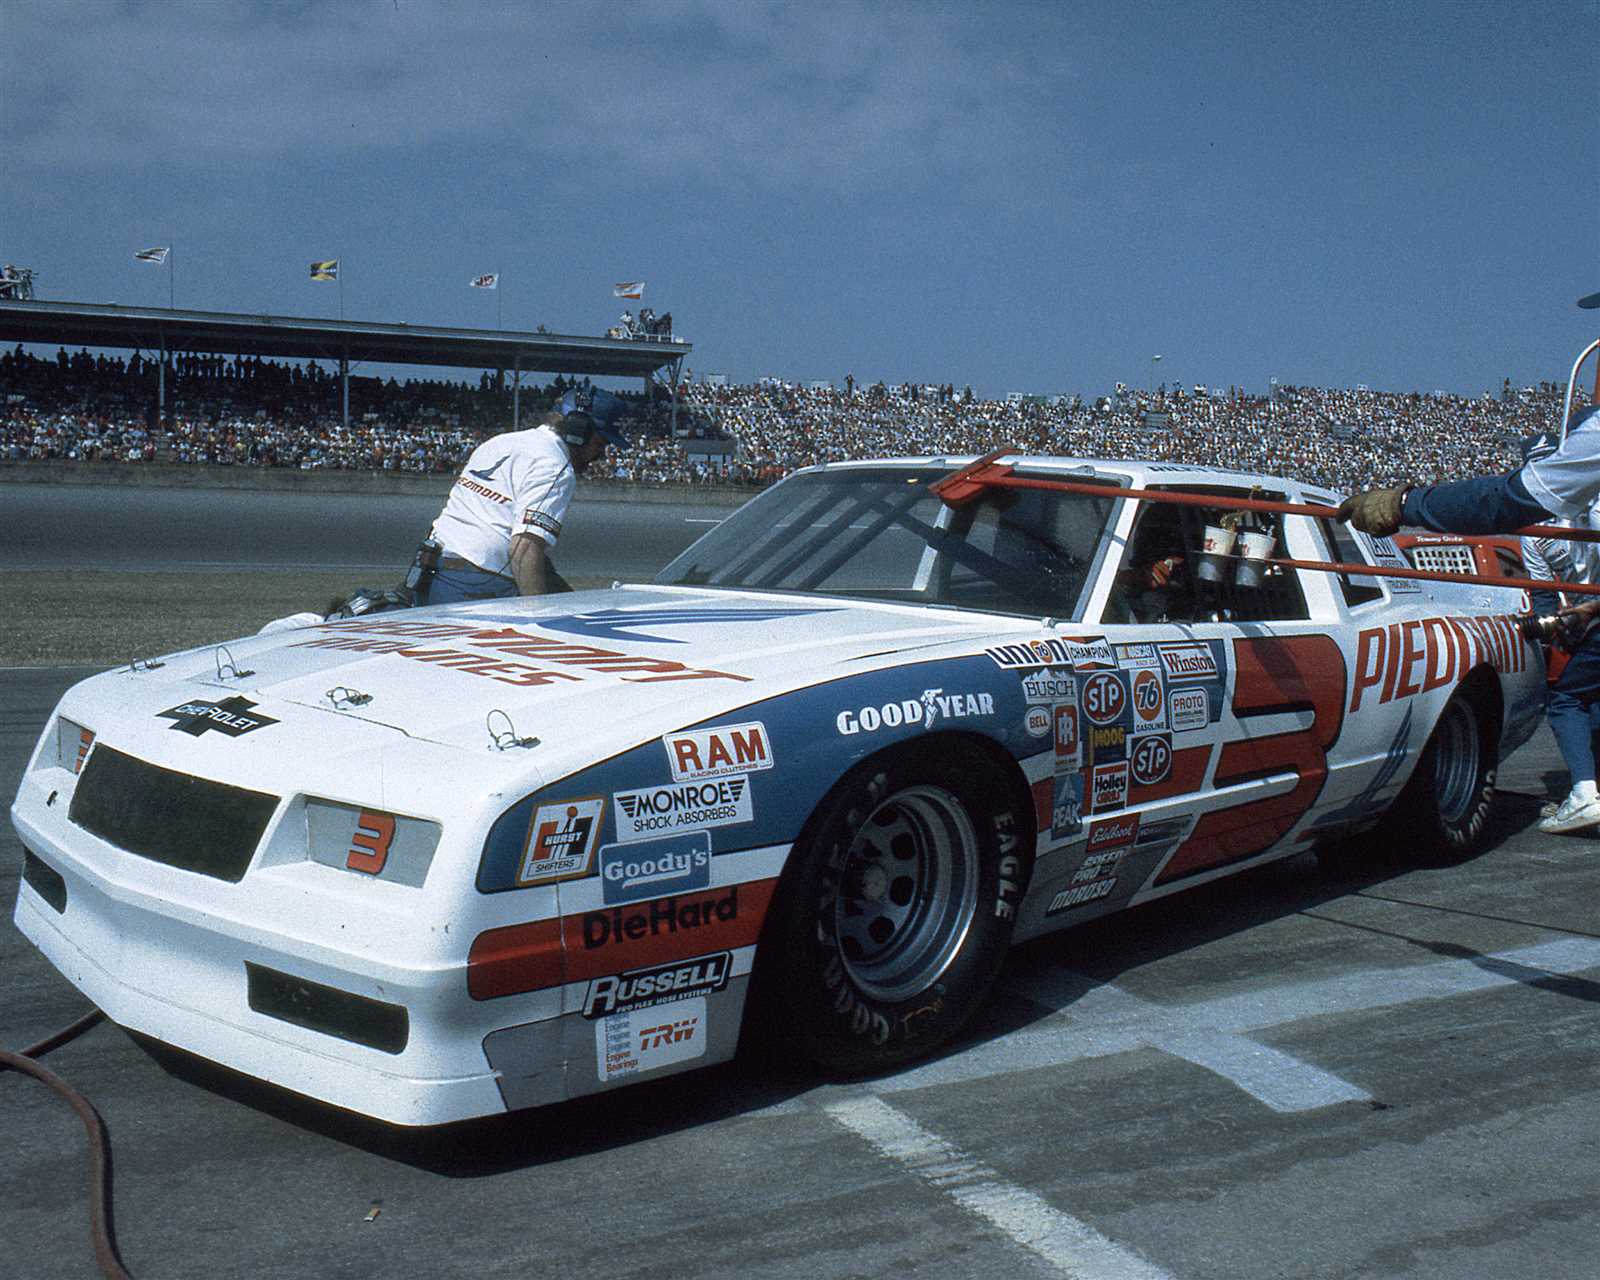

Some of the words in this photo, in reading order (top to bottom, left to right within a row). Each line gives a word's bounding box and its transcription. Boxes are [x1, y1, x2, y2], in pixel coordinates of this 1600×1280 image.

[457, 475, 513, 505] EDMONT
[1072, 646, 1110, 659] CHAMPION
[1163, 652, 1216, 673] Winston
[1025, 678, 1075, 697] BUSCH
[1088, 678, 1119, 713] STP
[1137, 680, 1158, 710] 76
[1173, 695, 1204, 710] PROTO
[176, 704, 258, 731] CHEVROLET
[1029, 715, 1049, 729] BELL
[673, 728, 766, 773] RAM
[1093, 726, 1125, 747] MOOG
[1137, 741, 1166, 773] STP
[1094, 774, 1127, 793] Holley
[636, 782, 729, 818] MONROE
[634, 818, 673, 833] SHOCK
[675, 805, 737, 826] ABSORBERS
[346, 808, 397, 876] 3
[544, 831, 583, 846] HURST
[535, 859, 576, 873] SHIFTERS
[603, 849, 708, 882] Goody's
[994, 811, 1020, 920] EAGLE
[583, 887, 738, 949] DieHard
[583, 961, 722, 1017] RUSSELL
[639, 1017, 698, 1051] TRW
